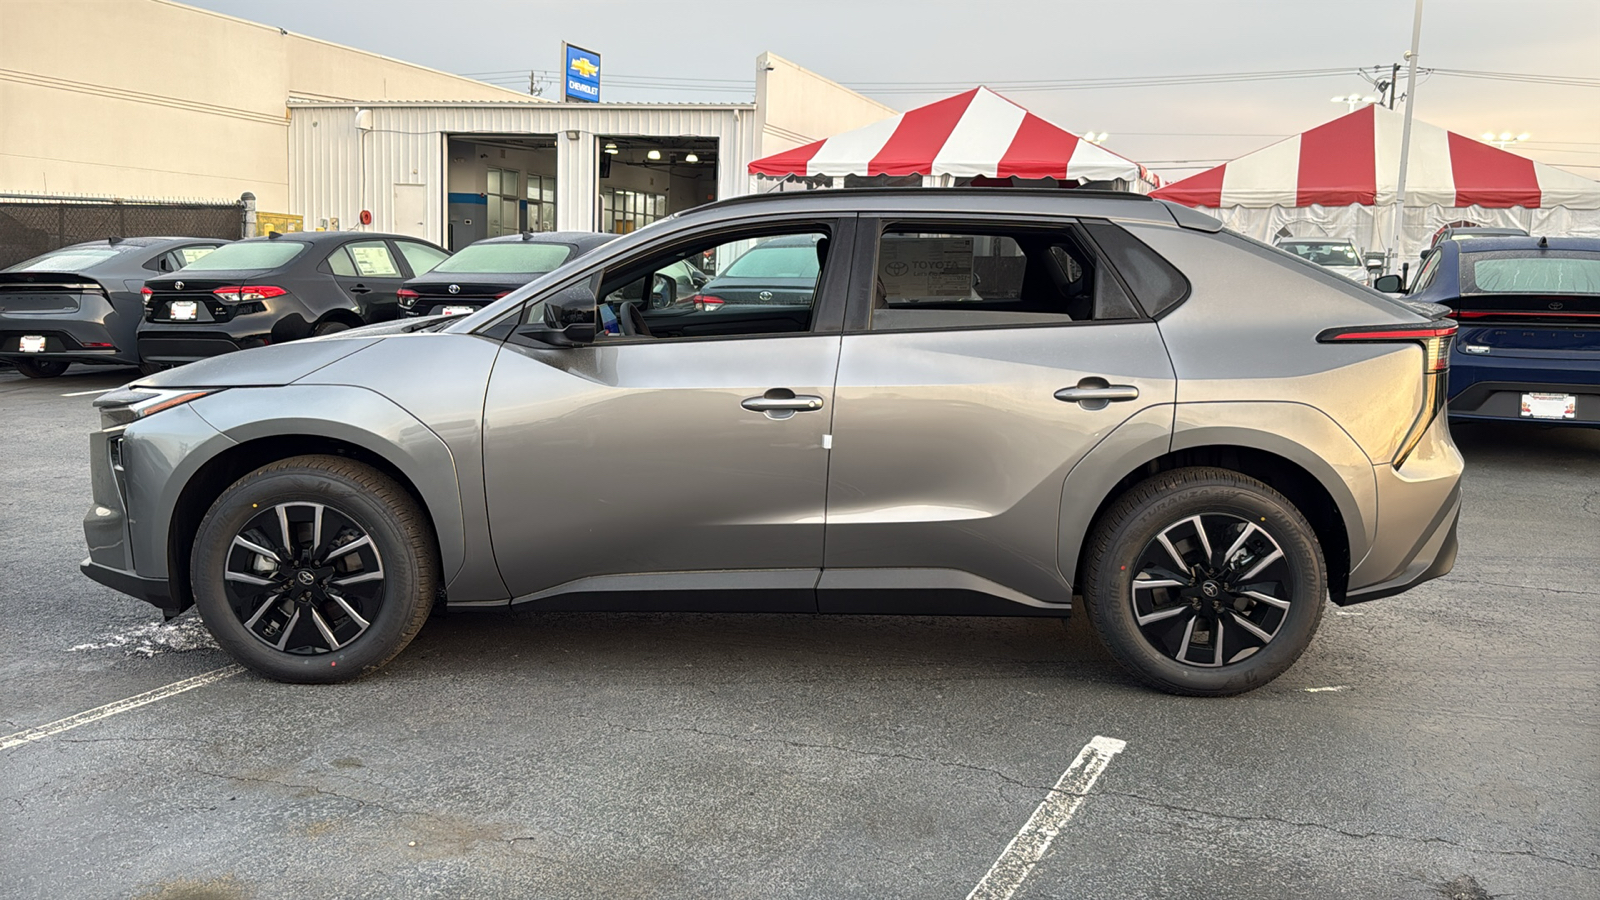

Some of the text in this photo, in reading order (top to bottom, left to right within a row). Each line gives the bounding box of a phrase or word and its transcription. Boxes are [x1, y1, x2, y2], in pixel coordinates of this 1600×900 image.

[569, 80, 598, 95] CHEVROLET
[912, 260, 958, 269] TOYOTA
[1138, 488, 1210, 523] TURANZA
